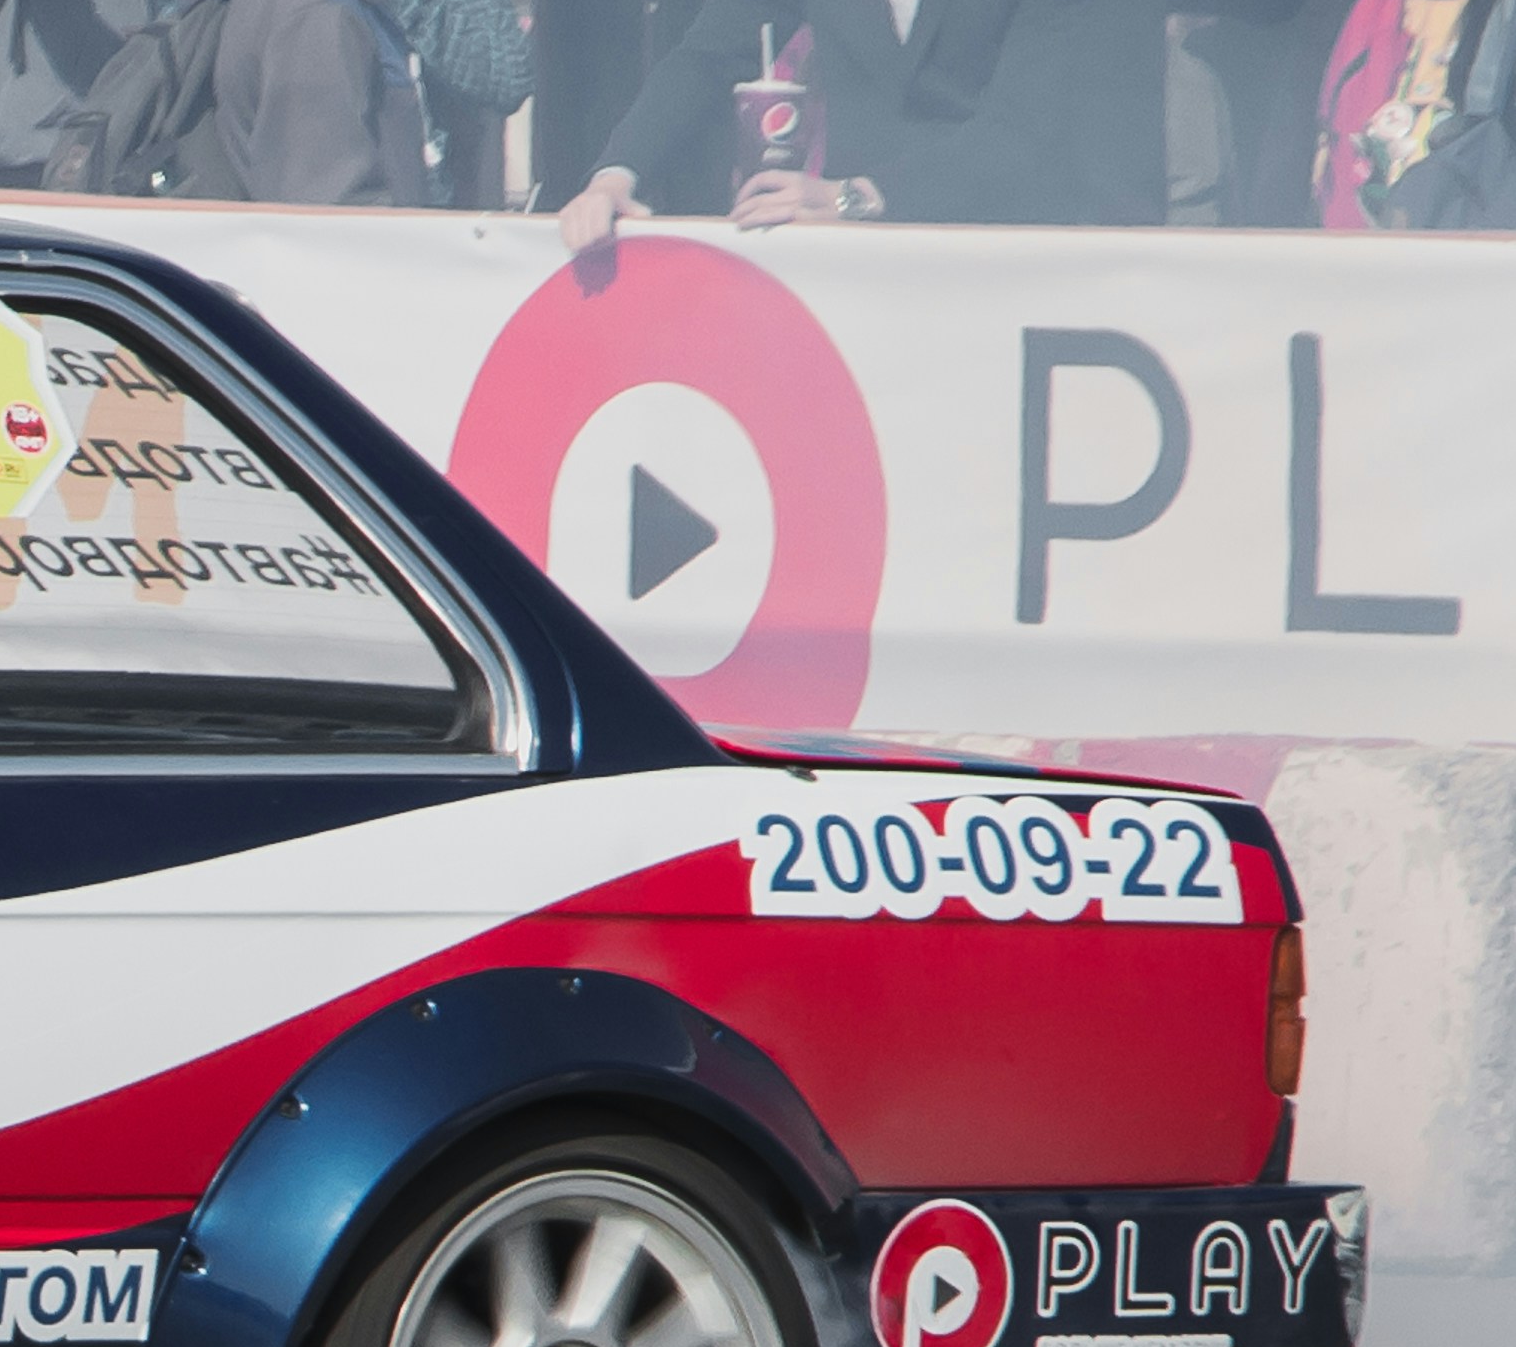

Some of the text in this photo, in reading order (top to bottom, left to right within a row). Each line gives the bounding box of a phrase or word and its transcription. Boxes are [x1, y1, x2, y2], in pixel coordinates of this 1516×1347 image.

[1016, 327, 1460, 635] PL
[756, 813, 1223, 899] 200-09-22
[1036, 1219, 1332, 1319] PLAY
